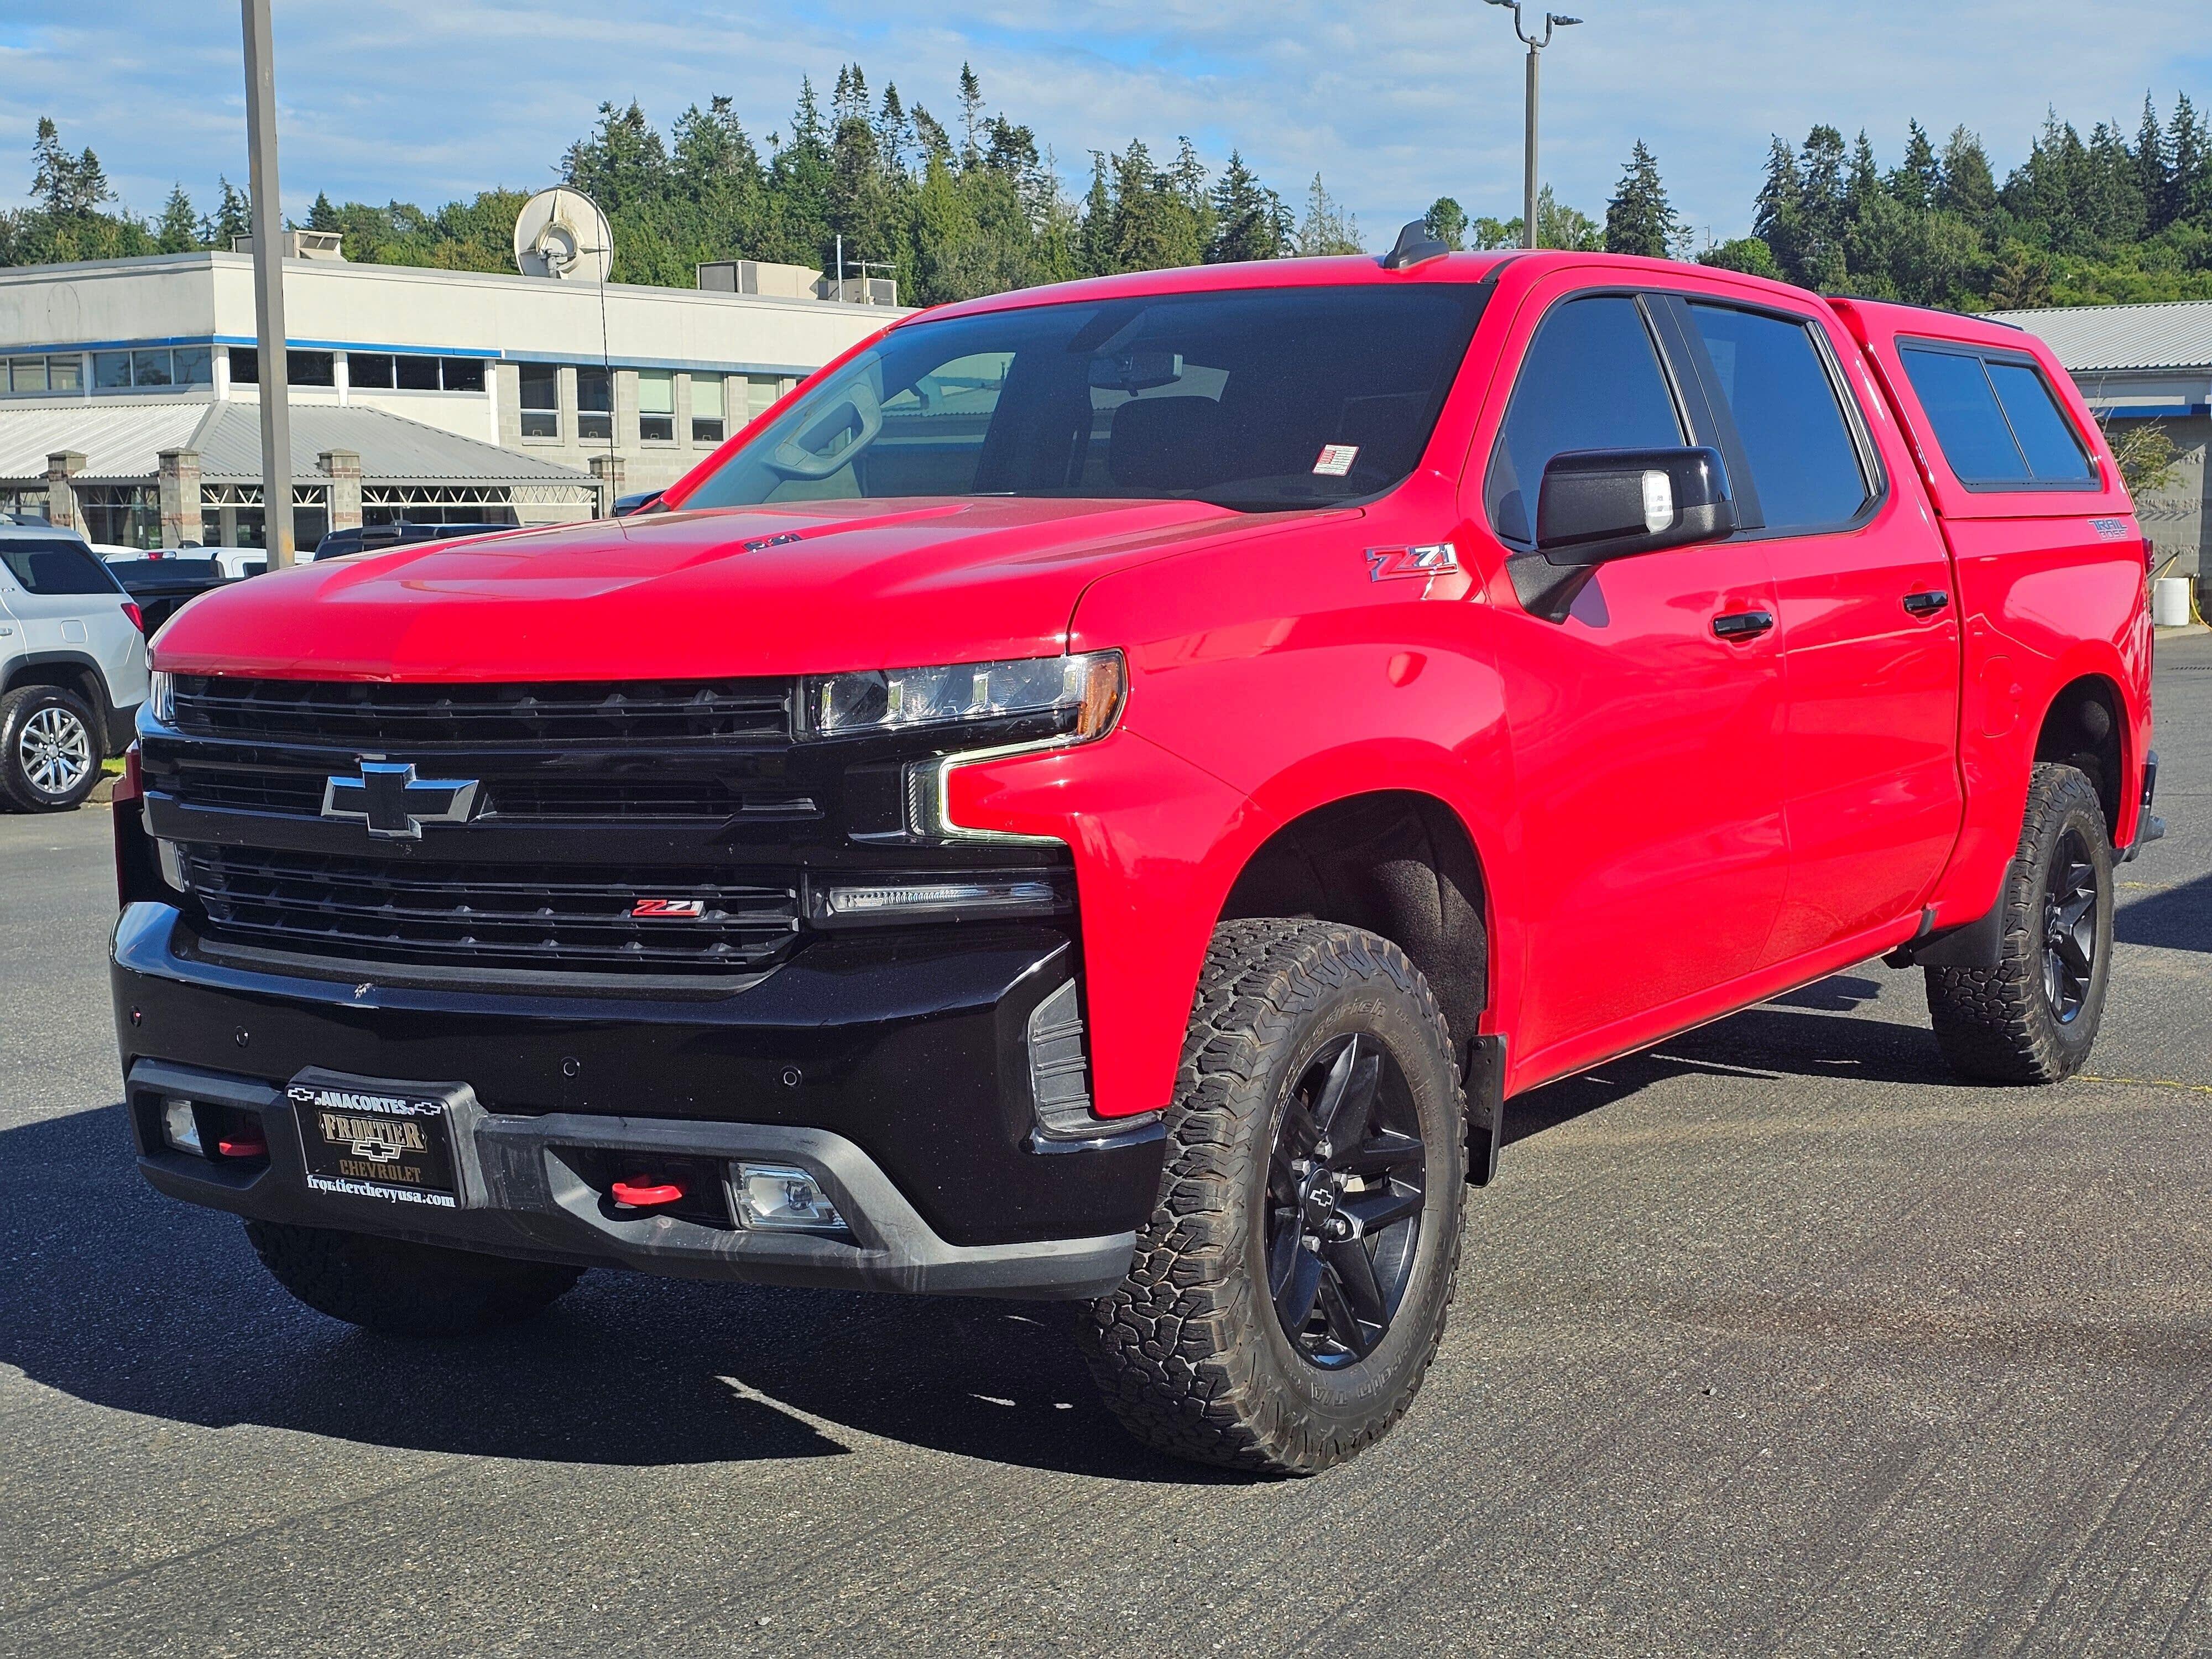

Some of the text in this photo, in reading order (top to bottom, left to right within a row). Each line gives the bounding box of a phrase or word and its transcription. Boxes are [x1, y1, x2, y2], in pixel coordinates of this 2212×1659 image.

[2087, 518, 2128, 531] TRAIL
[1363, 542, 1459, 582] Z71
[632, 899, 704, 916] Z71
[321, 1091, 410, 1115] ANACORTES
[322, 1113, 424, 1149] FRONTIER
[340, 1159, 420, 1183] CHEVROLET
[307, 1175, 456, 1208] frontierchevyusa.com
